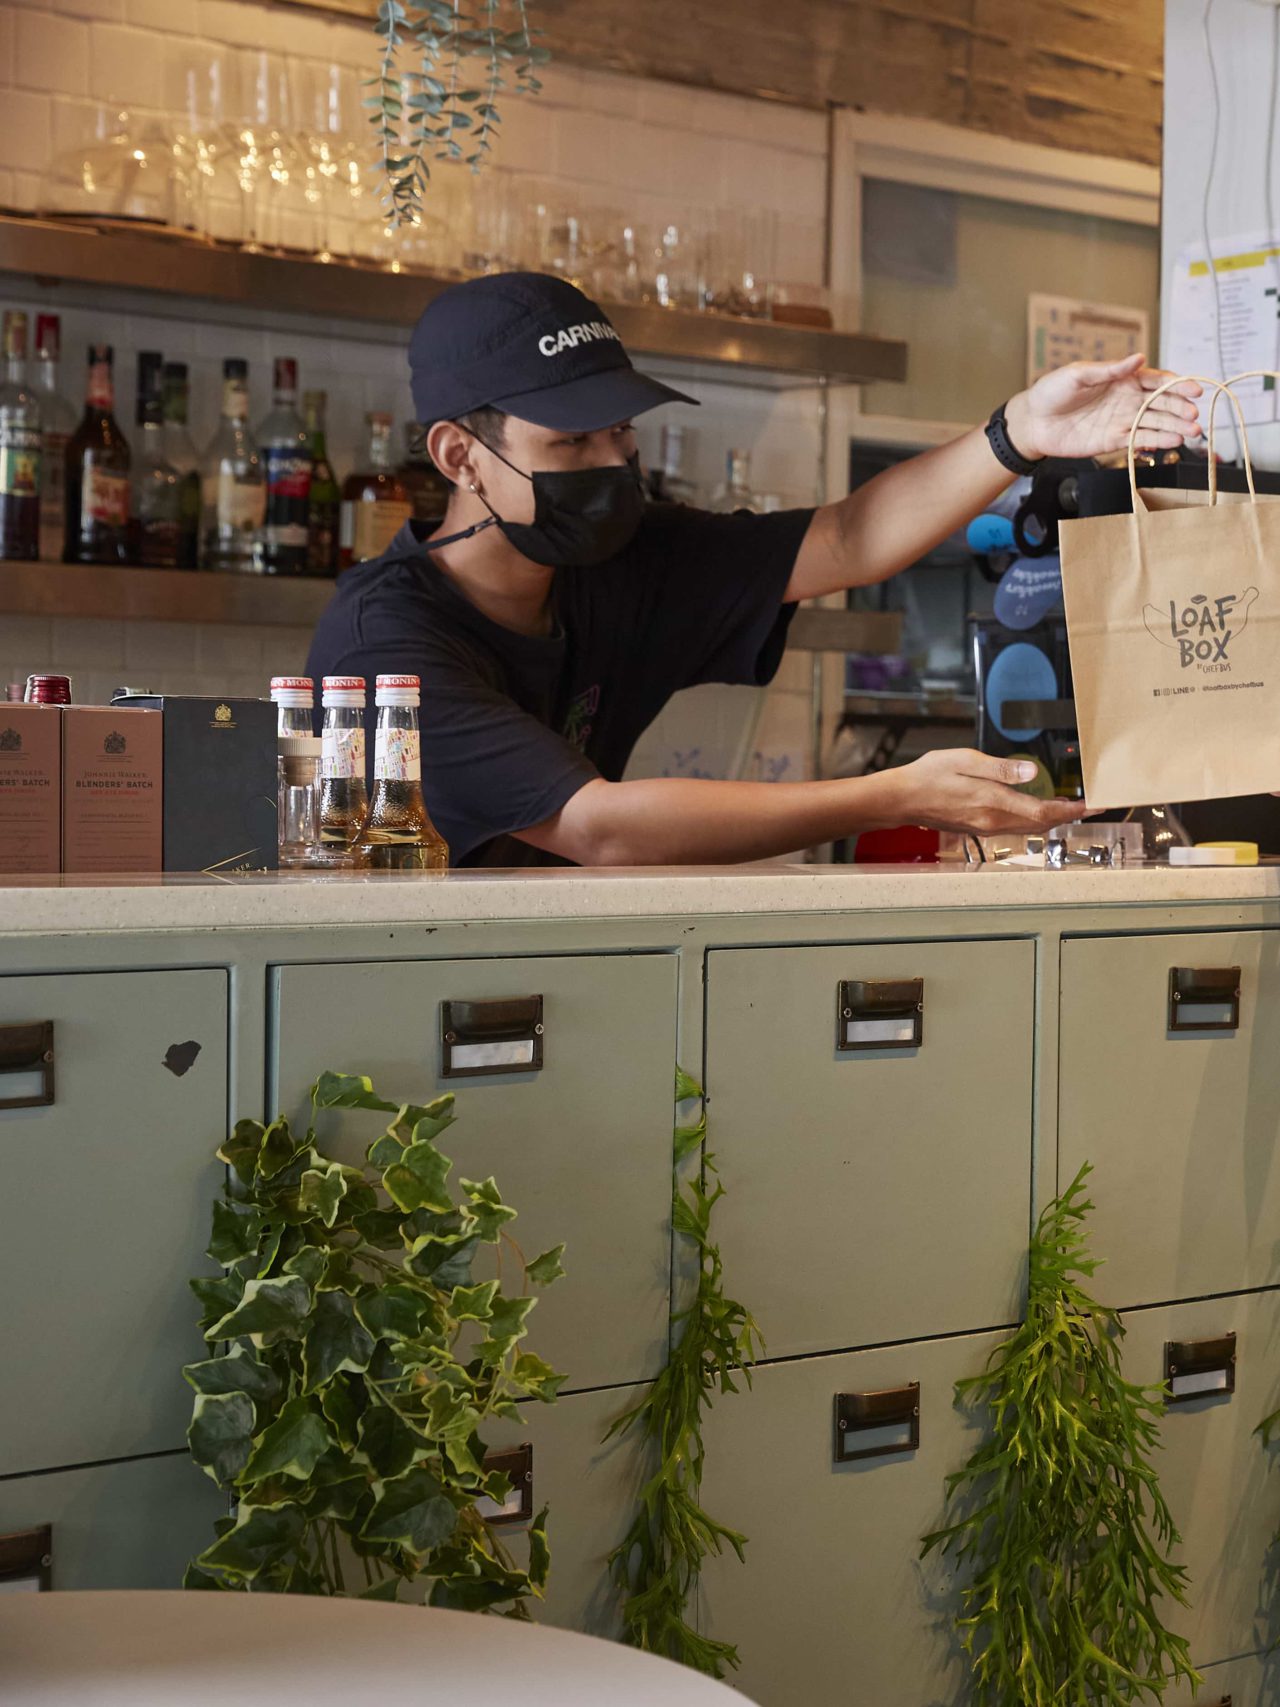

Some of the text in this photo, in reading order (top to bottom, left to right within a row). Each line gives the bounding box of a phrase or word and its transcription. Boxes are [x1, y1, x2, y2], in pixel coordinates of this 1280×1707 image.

[538, 321, 621, 357] CARNIVA
[1170, 595, 1236, 638] LOAF
[1177, 630, 1232, 668] BOX
[384, 677, 417, 686] MONIN
[22, 779, 50, 787] BATCH
[127, 781, 153, 789] BATCH
